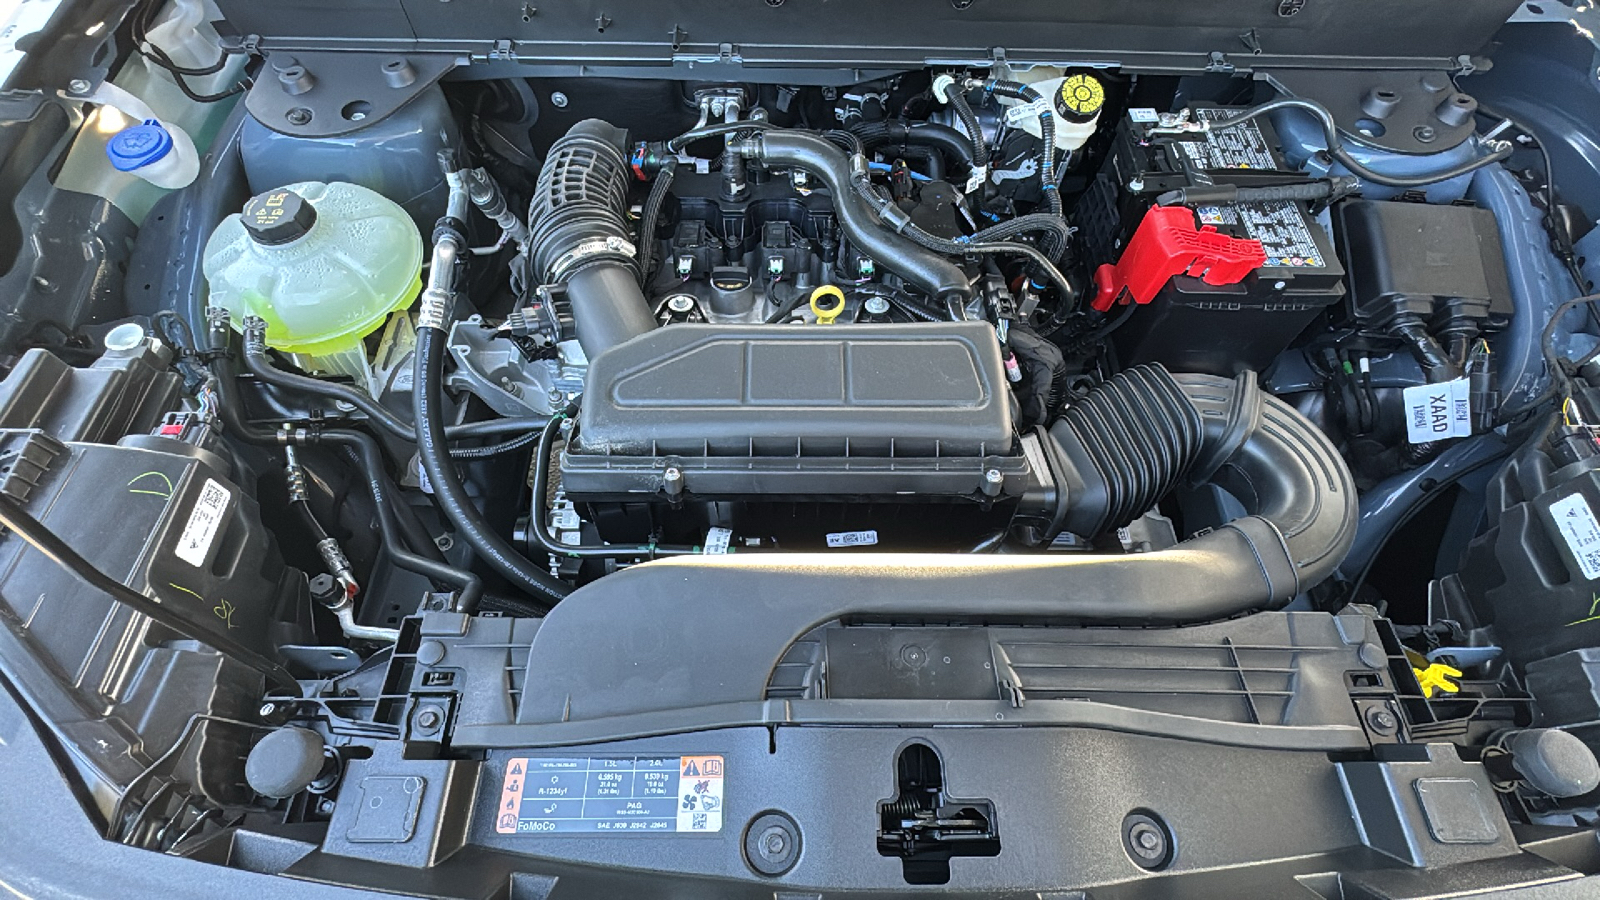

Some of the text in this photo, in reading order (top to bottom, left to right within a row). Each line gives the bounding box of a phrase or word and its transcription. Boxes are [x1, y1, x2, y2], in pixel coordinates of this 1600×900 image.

[1430, 393, 1448, 433] XAAD
[614, 773, 622, 782] kg
[538, 787, 568, 796] R-1234yf
[518, 821, 555, 831] FoMoCo
